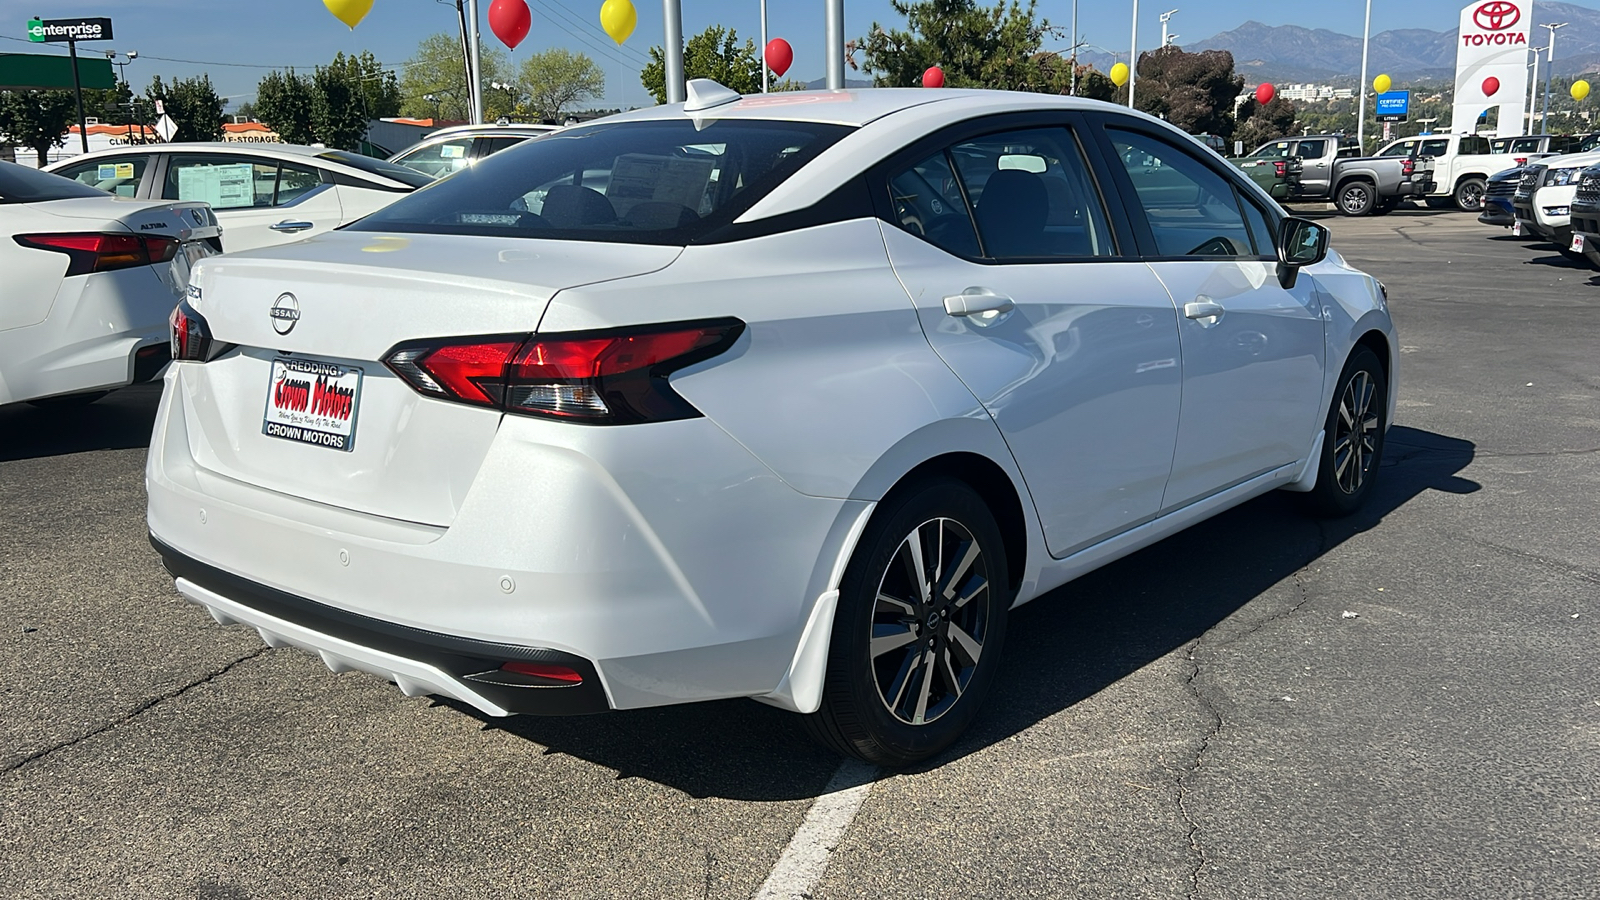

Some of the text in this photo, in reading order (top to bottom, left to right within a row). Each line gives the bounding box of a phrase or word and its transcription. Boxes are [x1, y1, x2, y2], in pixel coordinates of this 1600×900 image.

[29, 22, 102, 38] enterprise
[1462, 32, 1526, 47] TOYOTA
[270, 309, 300, 319] NISSAN
[290, 360, 338, 377] REDDING
[274, 376, 353, 422] Crown Motors
[267, 423, 344, 448] CROWN MOTORS
